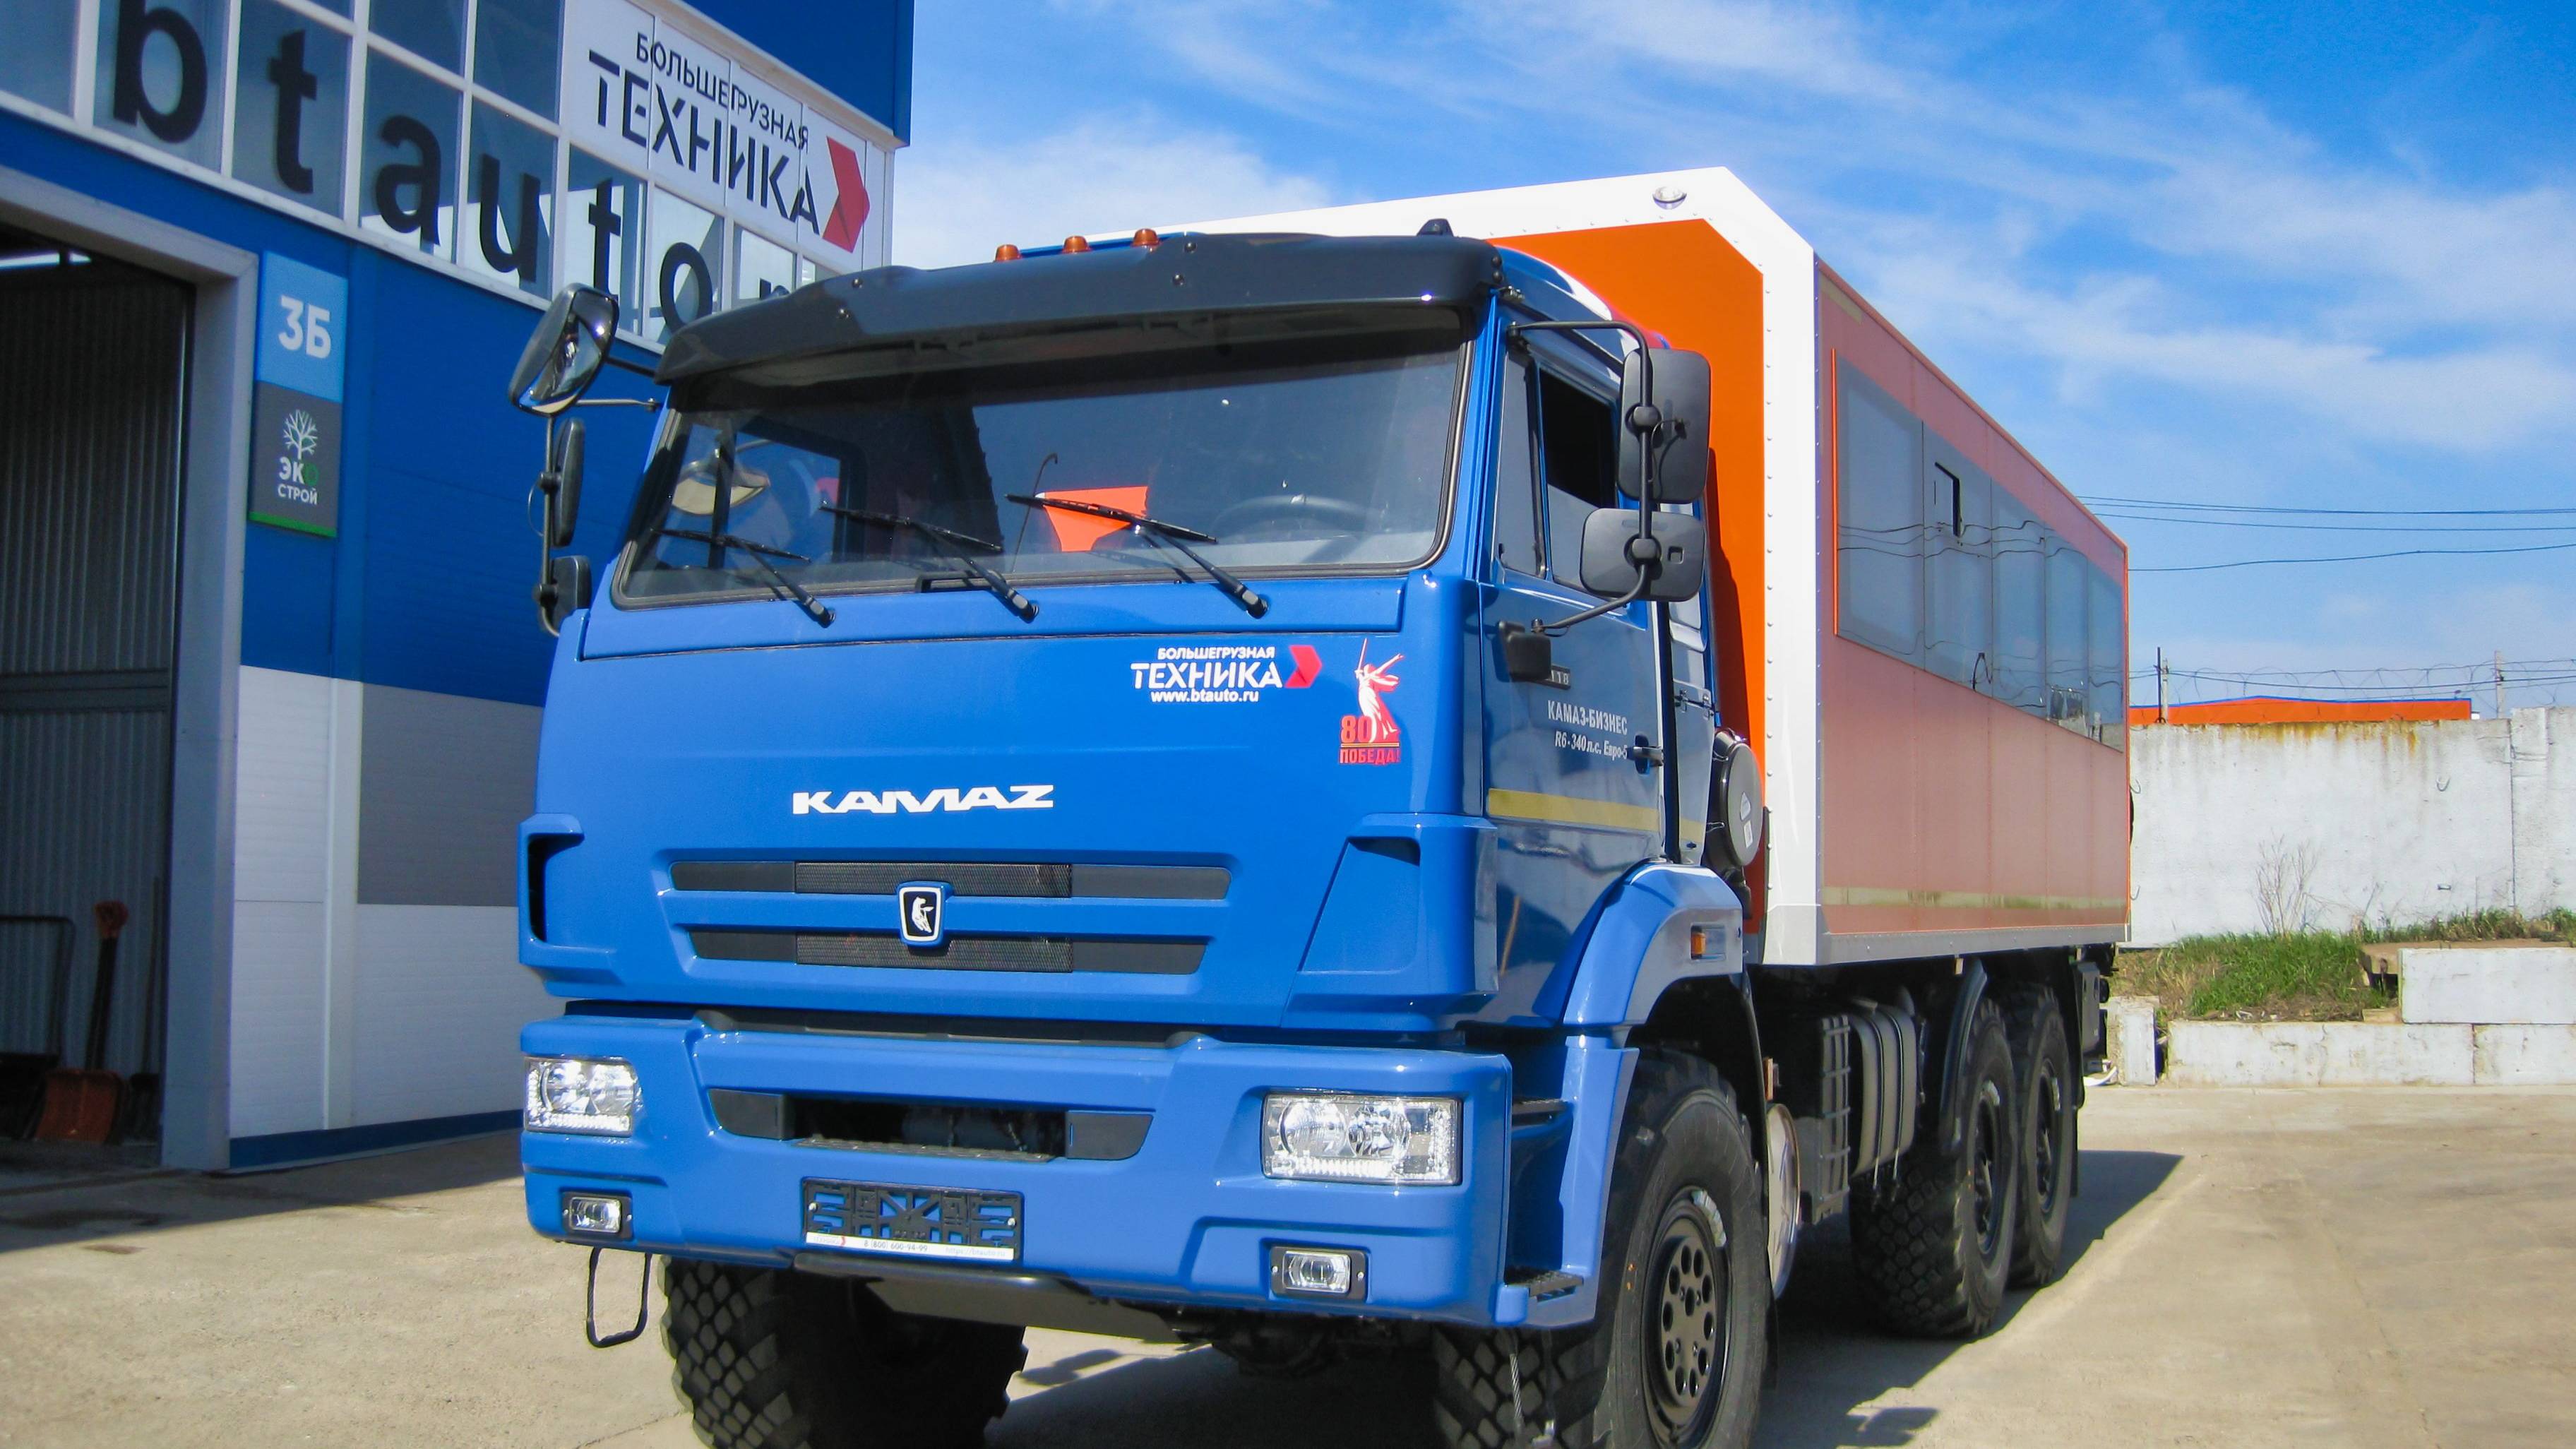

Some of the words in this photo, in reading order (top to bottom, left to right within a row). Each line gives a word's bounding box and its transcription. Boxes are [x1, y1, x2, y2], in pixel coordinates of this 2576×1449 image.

[637, 33, 809, 150] БОЛЬШЕГРУЗНАЯ
[589, 49, 821, 235] ТЕХНИКА
[278, 295, 331, 359] 3Б
[278, 456, 319, 487] ЭКО
[278, 484, 318, 506] СТРОЙ
[1157, 647, 1275, 660] БОЛЬШЕГРУЗНАЯ
[1131, 661, 1283, 689] ТЕХНИКА
[1150, 688, 1259, 703] www.btauto.ru
[1340, 715, 1373, 744] 80
[1547, 700, 1628, 736] КАМАЗ-БИЗНЕС
[1340, 749, 1400, 765] ПОБЕДА!
[792, 785, 1054, 815] KAMAZ
